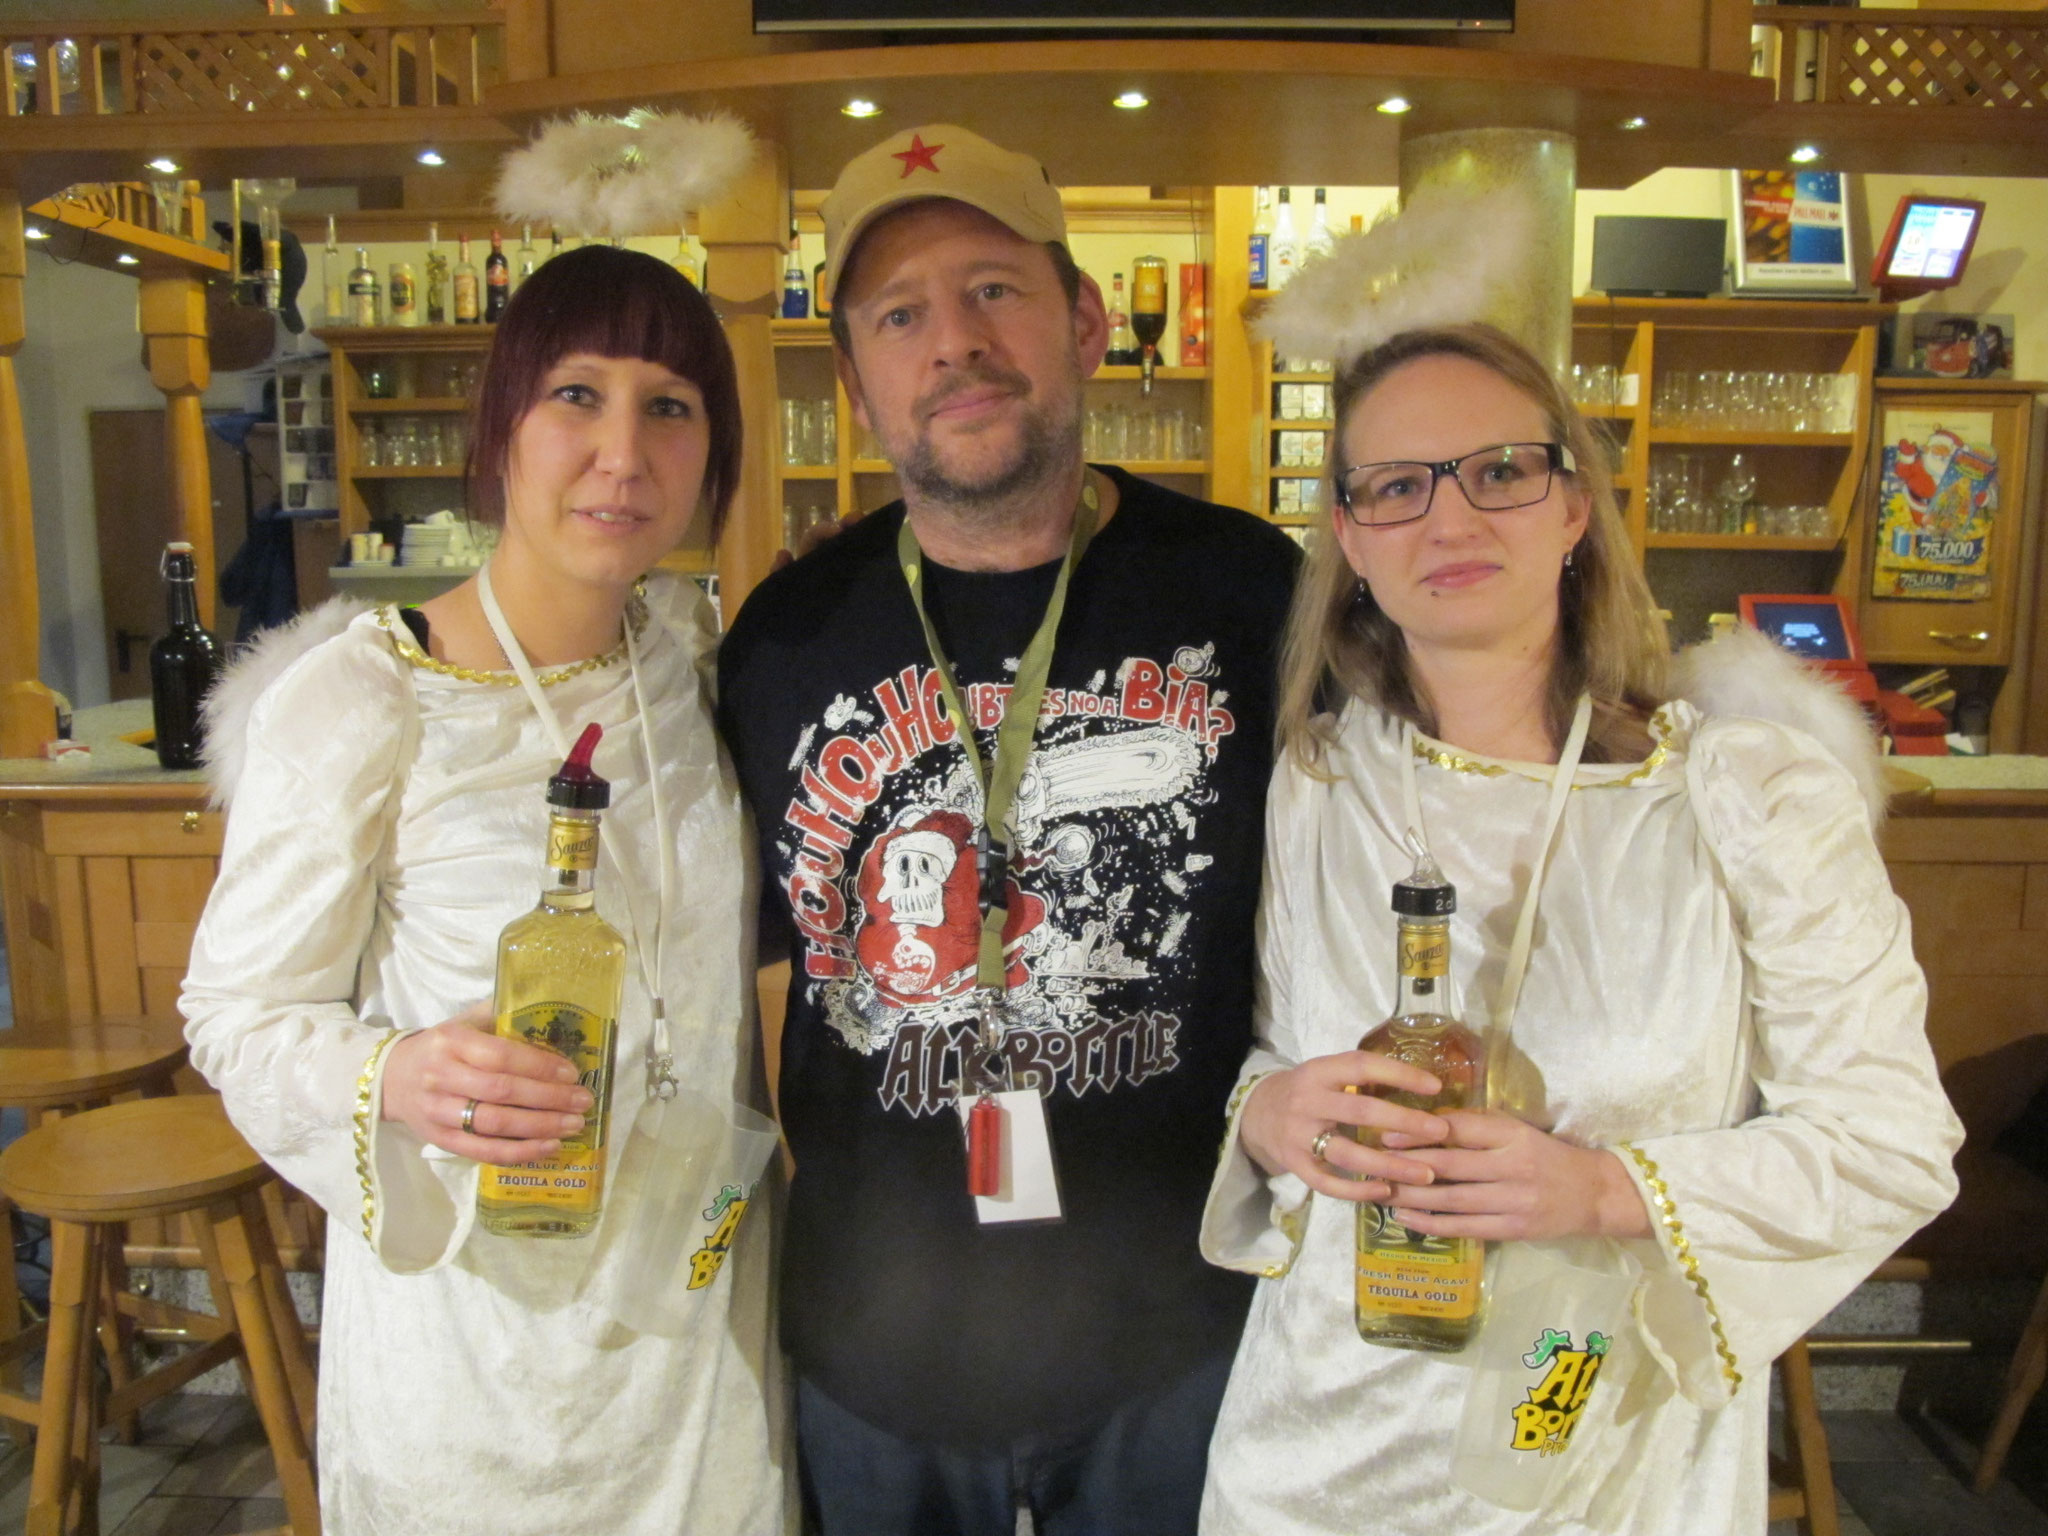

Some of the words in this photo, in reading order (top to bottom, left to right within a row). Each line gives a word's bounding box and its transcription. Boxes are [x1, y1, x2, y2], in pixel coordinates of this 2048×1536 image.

[497, 1175, 548, 1187] TEQUILA
[554, 1177, 587, 1188] GOLD
[1396, 1273, 1429, 1283] BLUE
[1368, 1285, 1419, 1299] TEQUILA
[1425, 1291, 1458, 1303] GOLD
